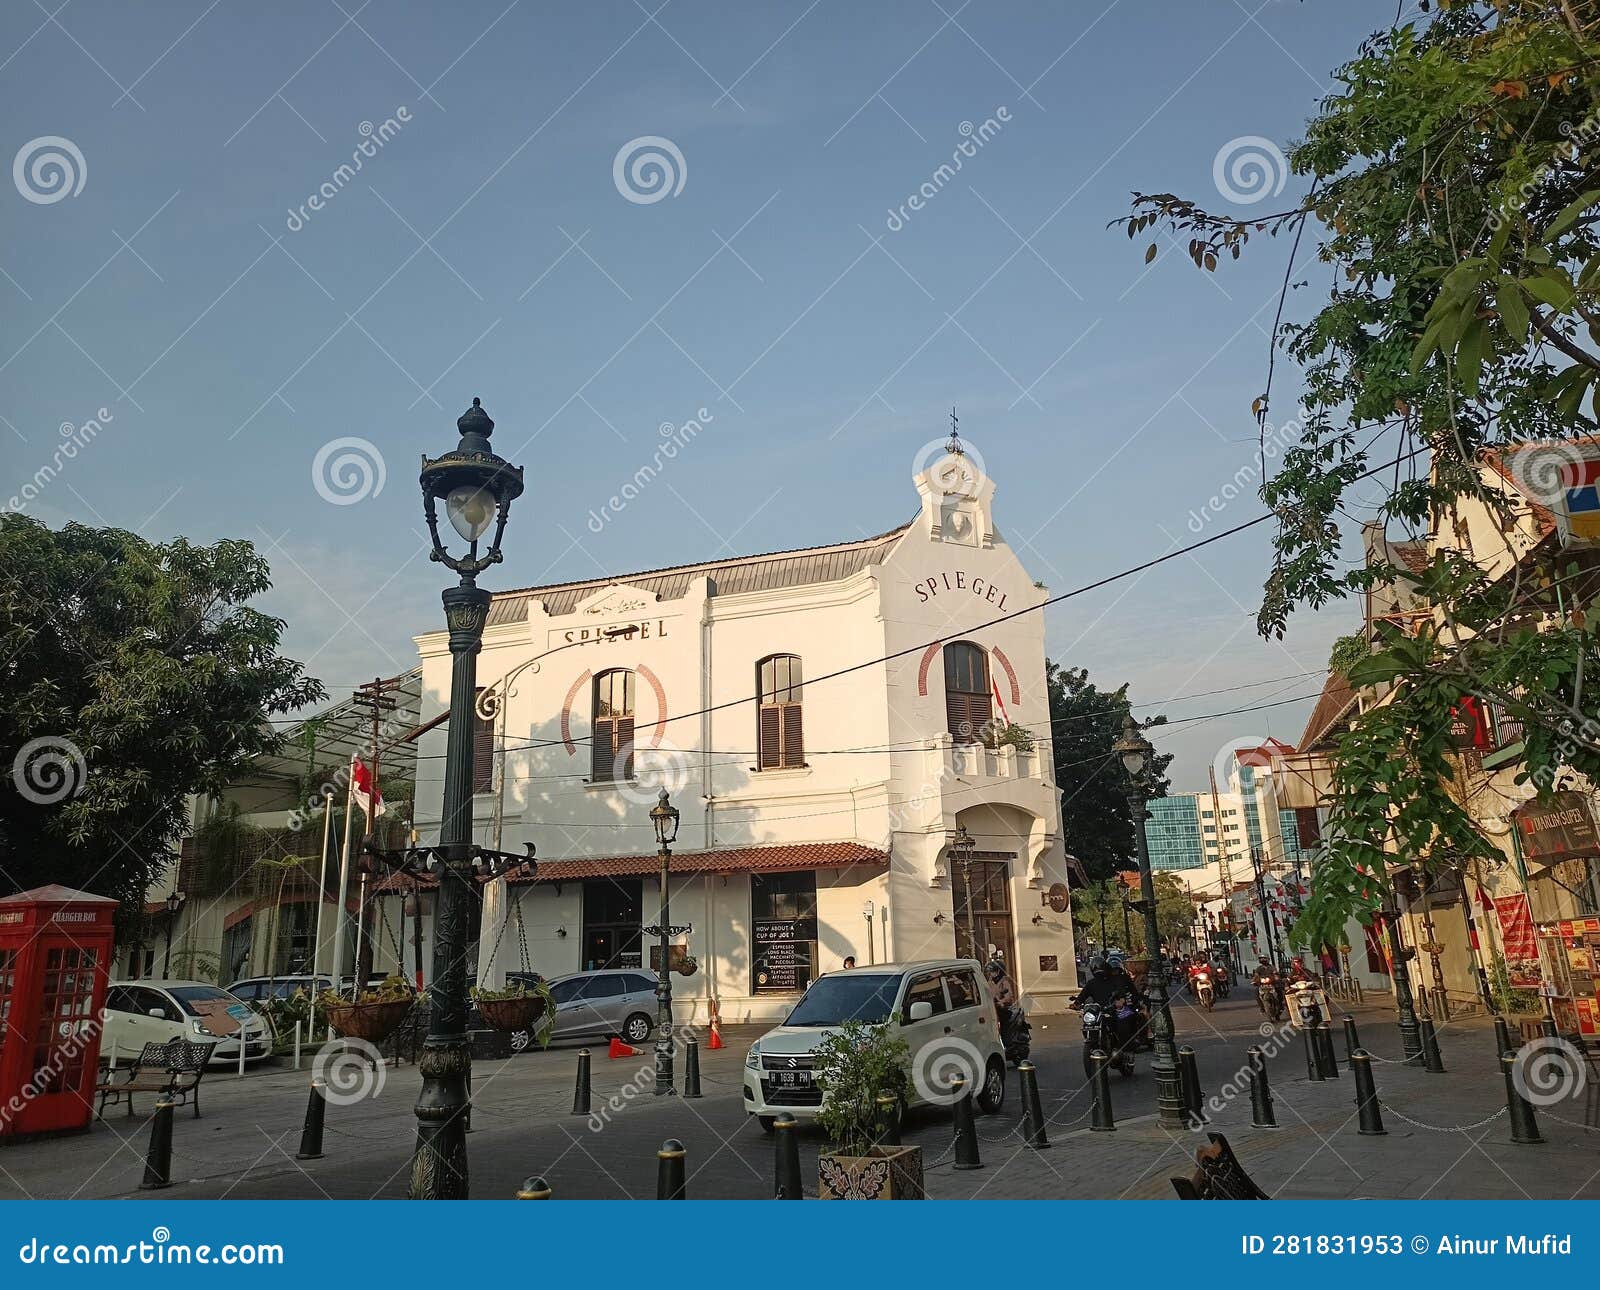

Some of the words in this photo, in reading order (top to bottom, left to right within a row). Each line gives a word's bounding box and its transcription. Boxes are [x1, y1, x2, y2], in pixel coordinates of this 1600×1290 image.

[915, 571, 1007, 612] SPIEGEL
[1560, 808, 1584, 825] SUPER
[52, 913, 82, 922] CHARGER
[83, 912, 96, 922] BOX
